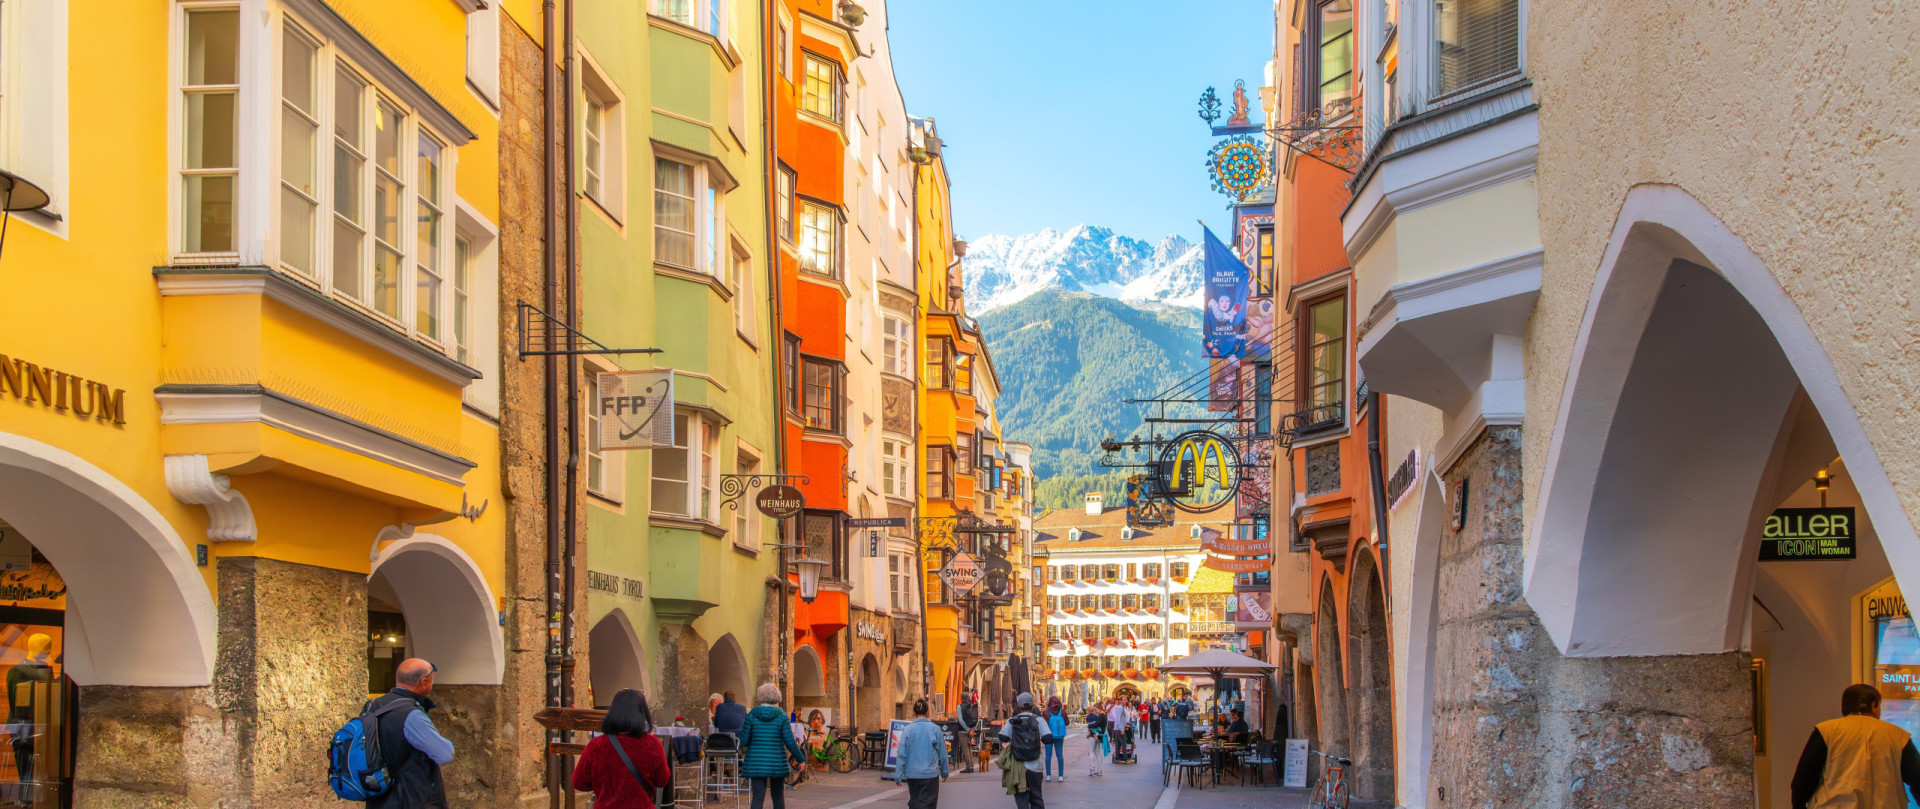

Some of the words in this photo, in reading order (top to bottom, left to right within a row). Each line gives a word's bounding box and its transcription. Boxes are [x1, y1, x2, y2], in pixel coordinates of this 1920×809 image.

[601, 395, 646, 416] FFP
[760, 499, 800, 508] WEINHAUS
[1778, 540, 1817, 556] ICON
[1820, 547, 1850, 555] WOMAN
[945, 568, 978, 578] SWING
[588, 570, 619, 593] EINHAUS
[1882, 673, 1911, 683] SAINT
